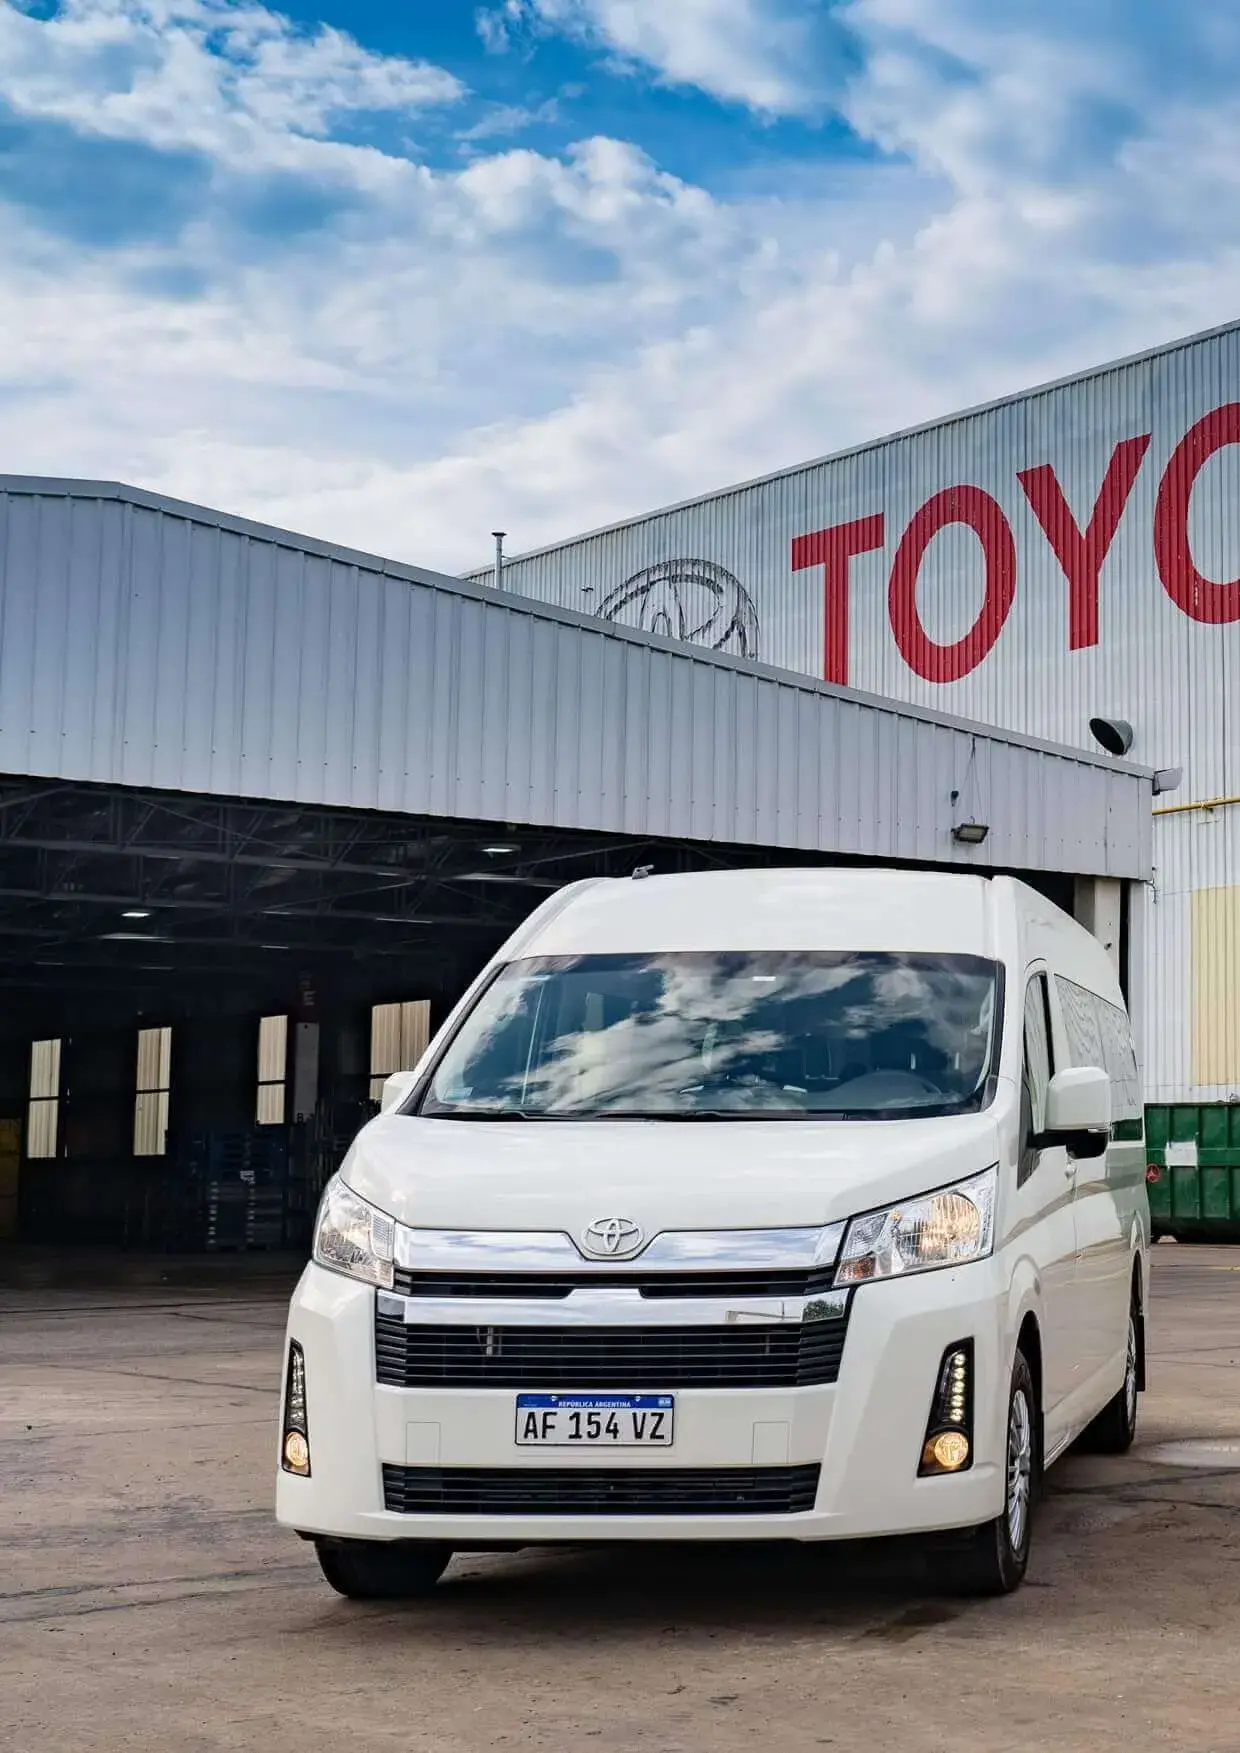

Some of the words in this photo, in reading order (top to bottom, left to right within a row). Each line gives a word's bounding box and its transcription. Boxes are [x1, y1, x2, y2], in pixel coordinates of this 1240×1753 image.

[594, 1400, 631, 1408] ARGENTINA
[523, 1411, 558, 1439] AF
[568, 1411, 620, 1439] 154
[632, 1411, 665, 1439] VZ
